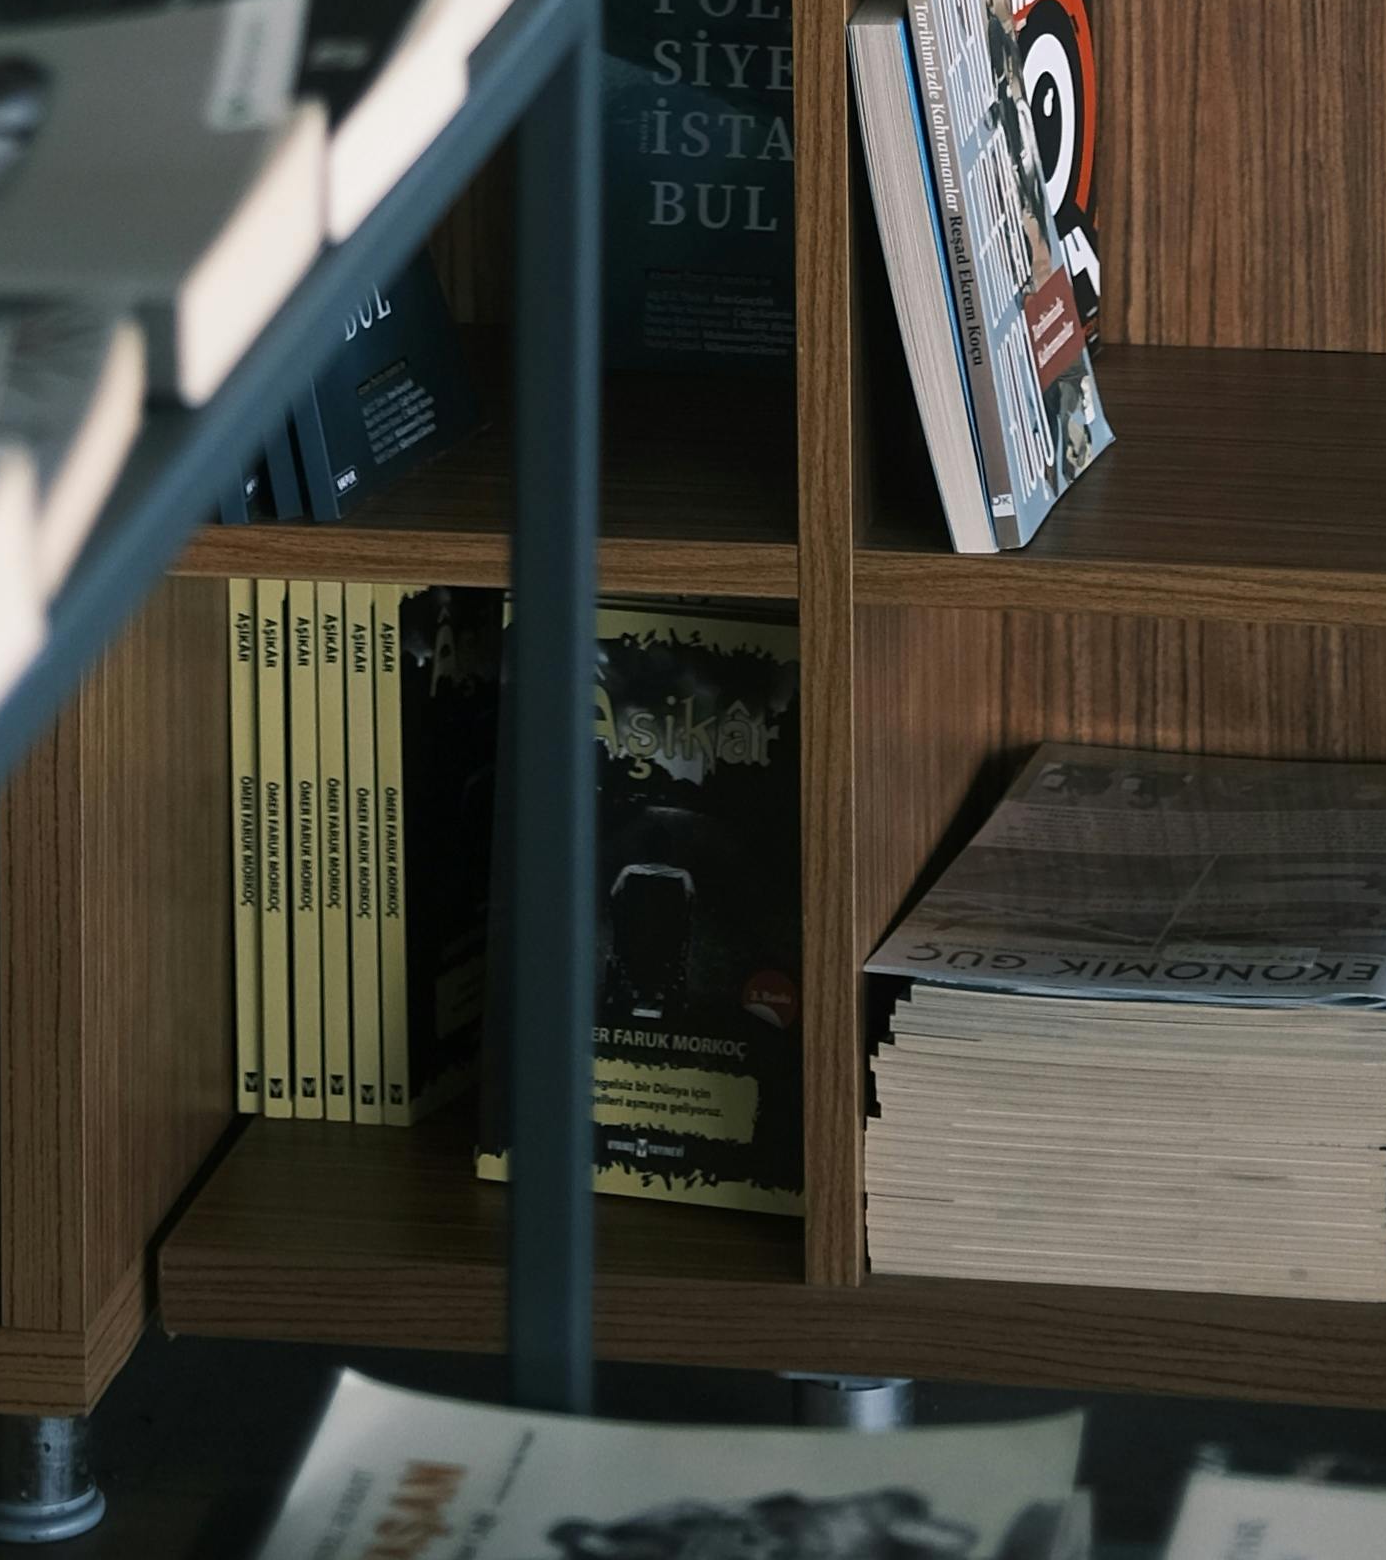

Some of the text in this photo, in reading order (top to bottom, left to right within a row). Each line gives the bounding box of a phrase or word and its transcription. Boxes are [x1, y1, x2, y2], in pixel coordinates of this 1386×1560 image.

[650, 181, 778, 232] BUL
[914, 1, 983, 367] Tarihimizde Kahramanlar Reşad Ekrem Koçu
[907, 942, 1381, 984] EKONOMİK GÜÇ
